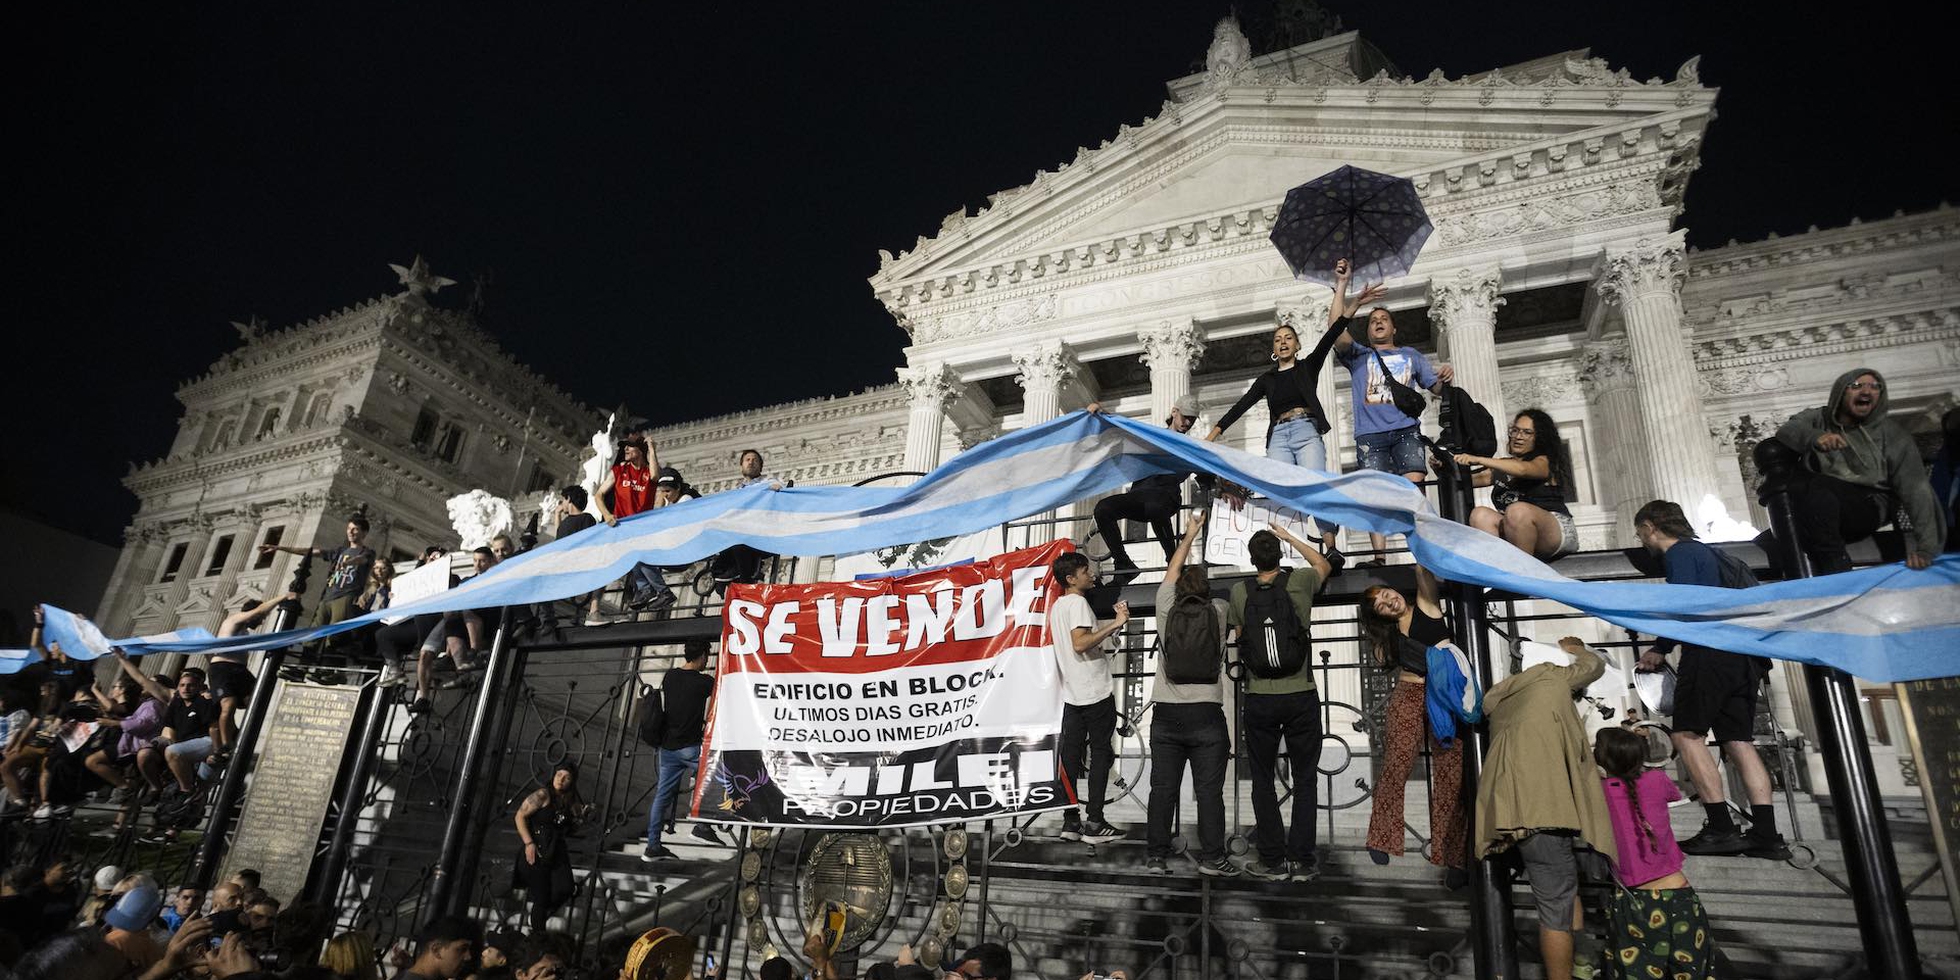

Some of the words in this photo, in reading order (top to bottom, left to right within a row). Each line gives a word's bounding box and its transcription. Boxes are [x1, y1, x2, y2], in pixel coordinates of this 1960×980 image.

[1208, 534, 1303, 559] GENL
[728, 599, 799, 655] SE
[816, 565, 1049, 657] VENDE
[754, 683, 852, 700] EDIFICIO
[861, 680, 898, 699] EN
[908, 664, 1004, 696] BLOCK.
[774, 707, 850, 721] ULTIMOS
[855, 705, 901, 721] DIAS
[908, 694, 978, 718] GRATIS.
[768, 727, 870, 743] DESALOJO
[877, 714, 979, 742] INMEDIATO.
[786, 750, 1055, 796] MILEI
